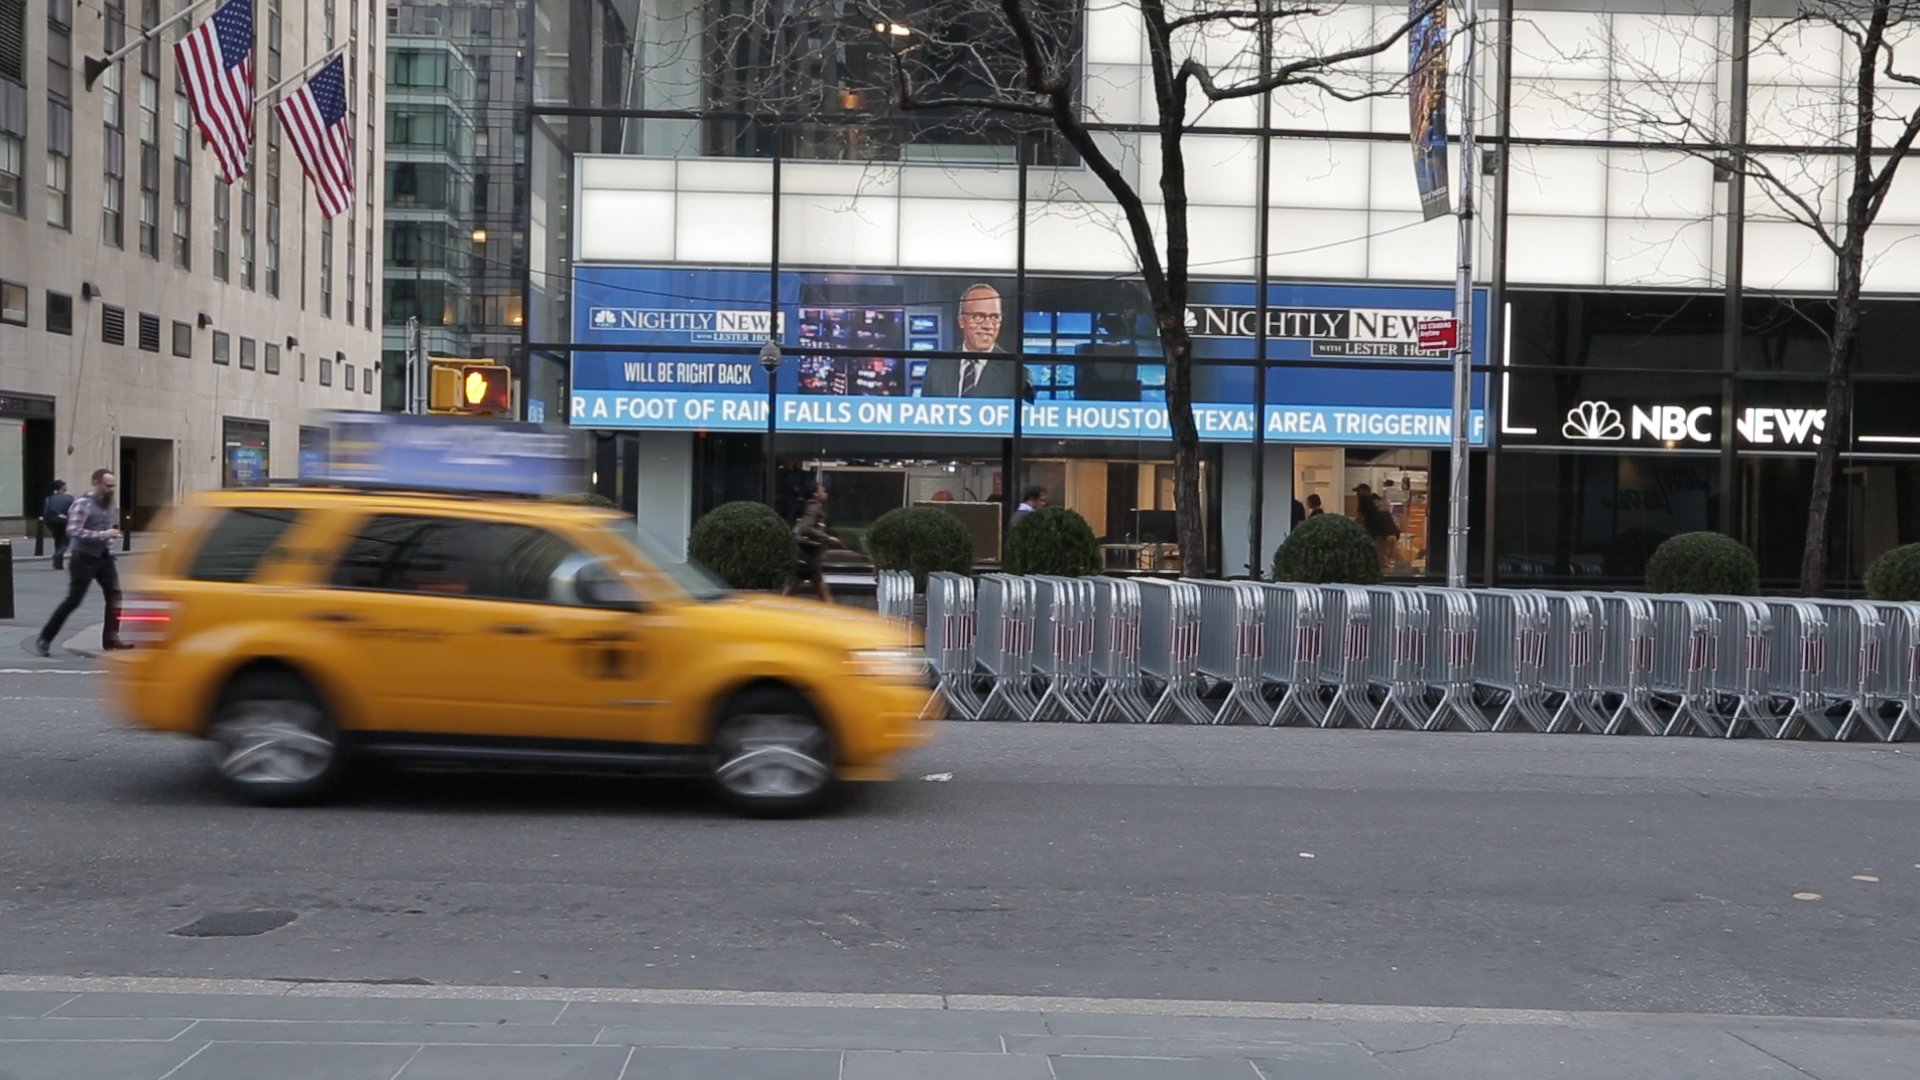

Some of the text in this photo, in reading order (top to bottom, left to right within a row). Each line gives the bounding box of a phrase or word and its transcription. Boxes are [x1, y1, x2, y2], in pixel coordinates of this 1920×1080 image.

[620, 310, 781, 332] NIGHTLY NEW
[1354, 312, 1445, 339] NEW
[713, 332, 750, 342] LESTER
[1319, 344, 1342, 353] WITH
[1345, 342, 1399, 356] LESTER
[624, 362, 752, 385] WILL BE RIGHT BACK
[591, 397, 609, 419] A
[615, 397, 678, 420] FOOT
[684, 398, 716, 421] OF
[783, 401, 852, 424] FALLS
[858, 403, 892, 425] ON
[900, 404, 972, 426] PARTS
[979, 405, 1009, 427] OF
[1021, 405, 1060, 428] THE
[1268, 411, 1328, 435] AREA
[1333, 412, 1454, 437] TRIGGERIN
[1631, 404, 1712, 442] NBC
